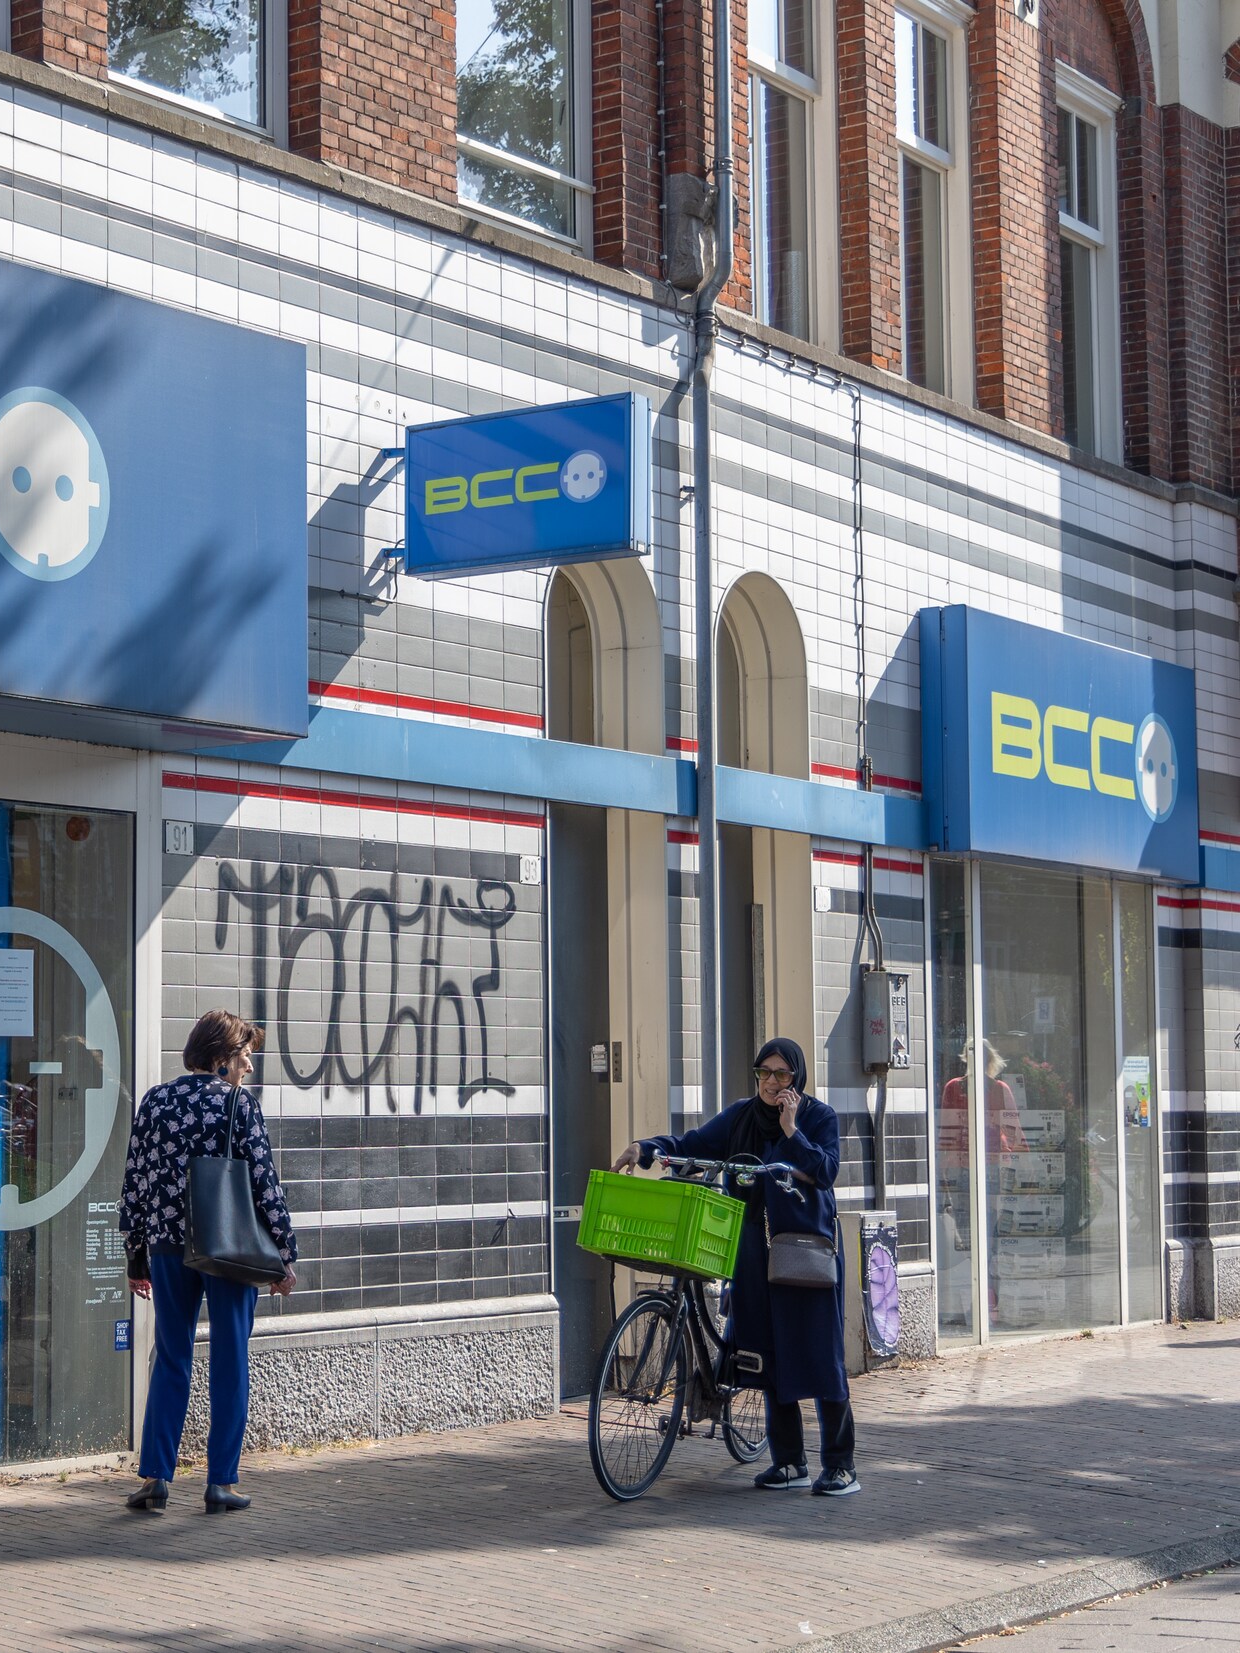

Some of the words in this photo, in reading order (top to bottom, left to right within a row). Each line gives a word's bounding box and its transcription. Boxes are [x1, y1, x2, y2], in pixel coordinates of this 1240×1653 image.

[425, 461, 560, 515] BCC
[991, 692, 1136, 801] BCC
[173, 825, 187, 851] 91
[525, 858, 537, 881] 93
[88, 1202, 116, 1212] BCC
